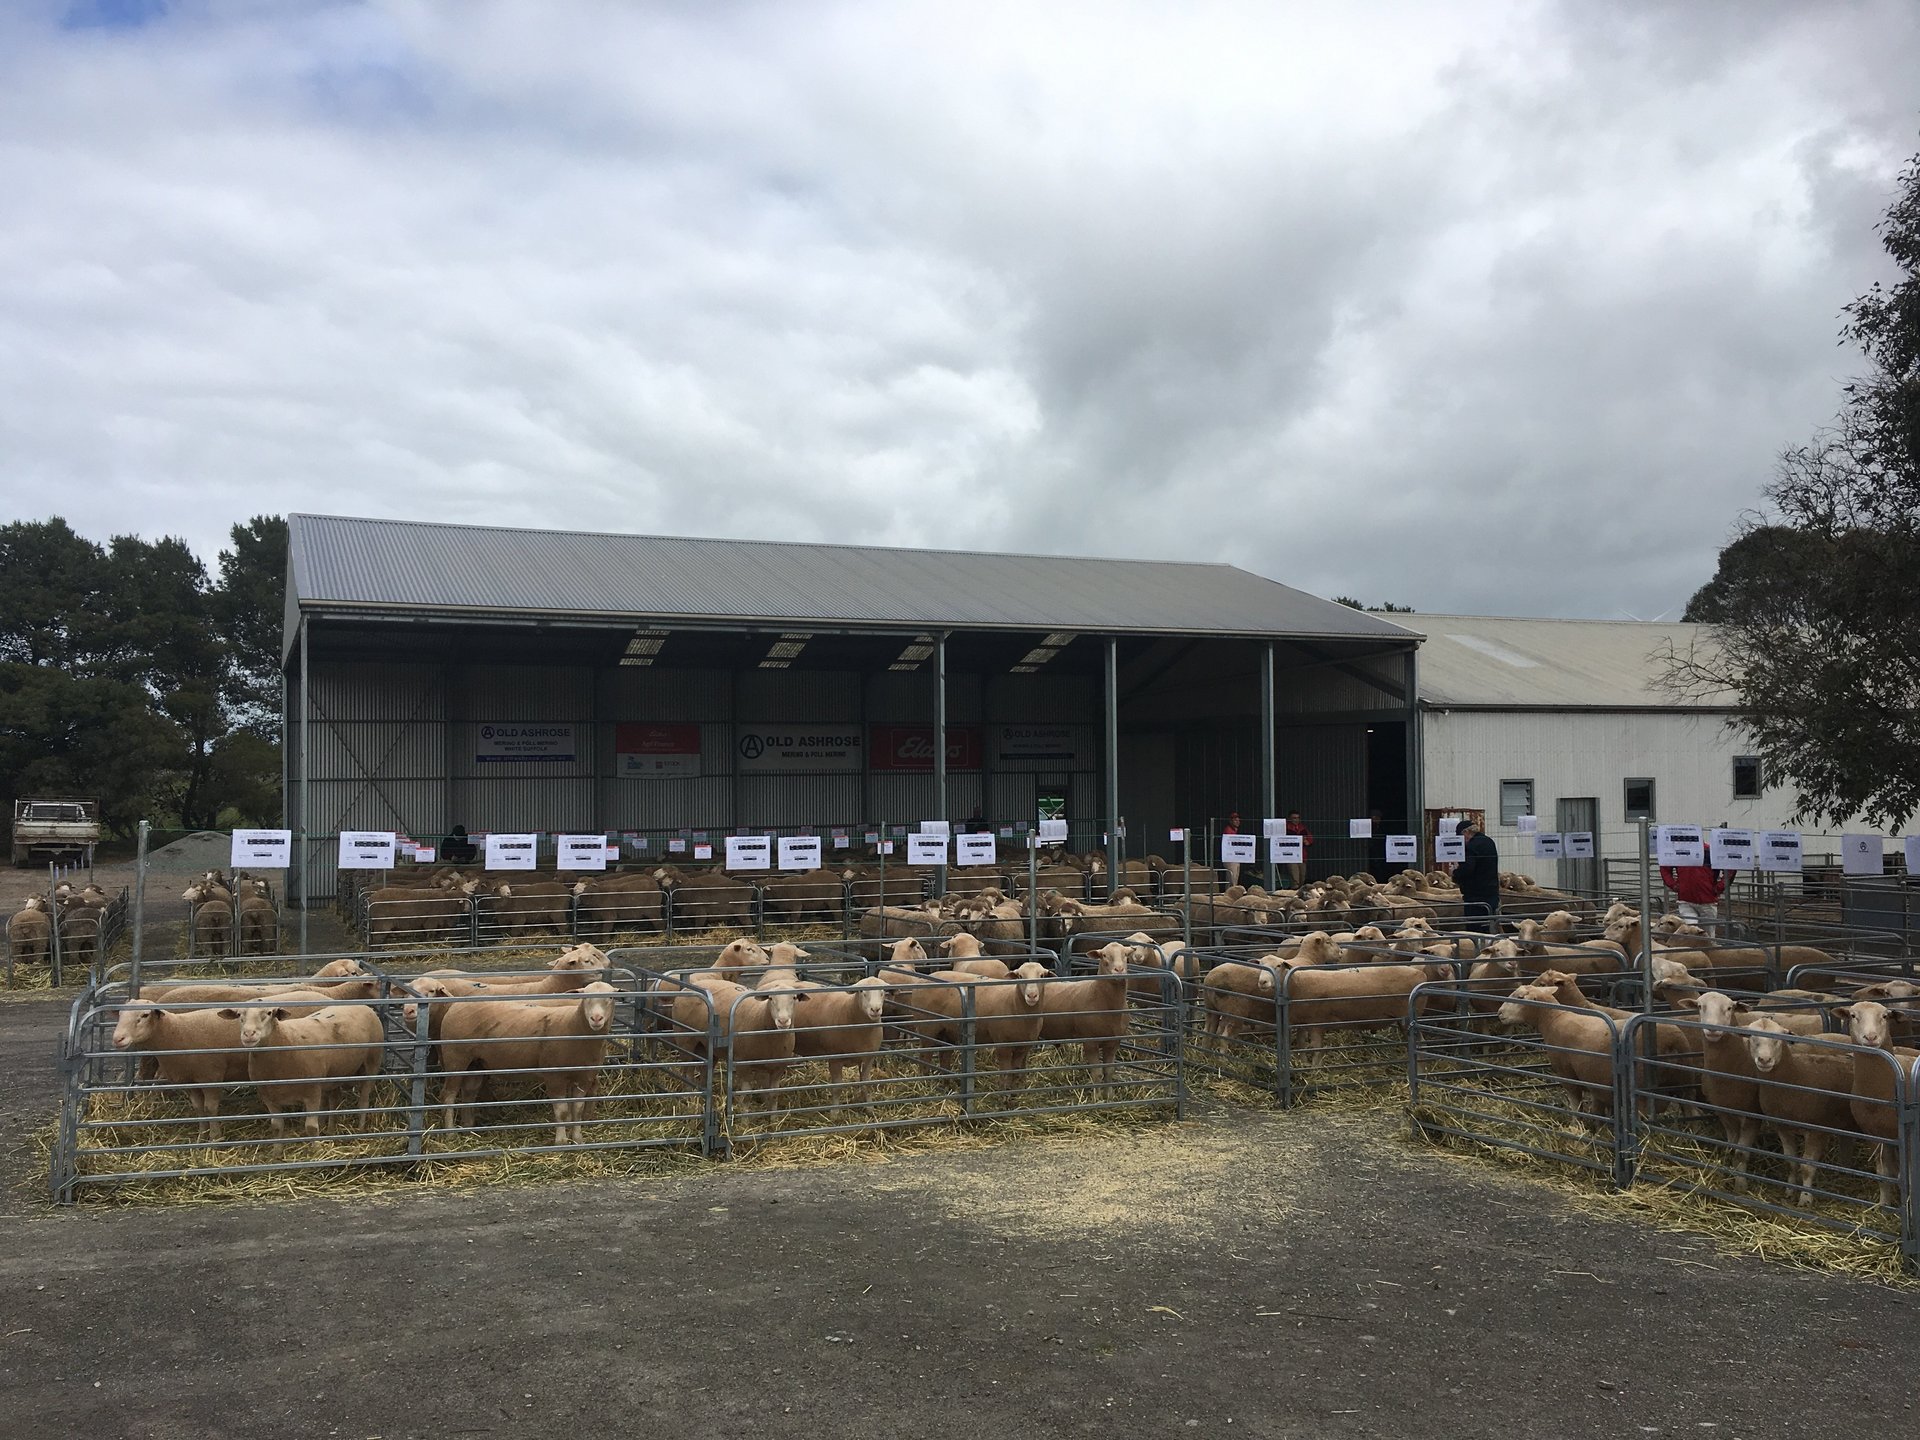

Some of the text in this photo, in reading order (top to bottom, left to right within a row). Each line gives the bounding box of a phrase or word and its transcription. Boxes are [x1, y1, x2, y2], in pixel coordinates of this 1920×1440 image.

[496, 728, 519, 737] OLD
[519, 728, 571, 737] ASHROSE
[766, 736, 794, 747] OLD
[798, 736, 861, 747] ASHROSE
[897, 736, 963, 759] Eldrs
